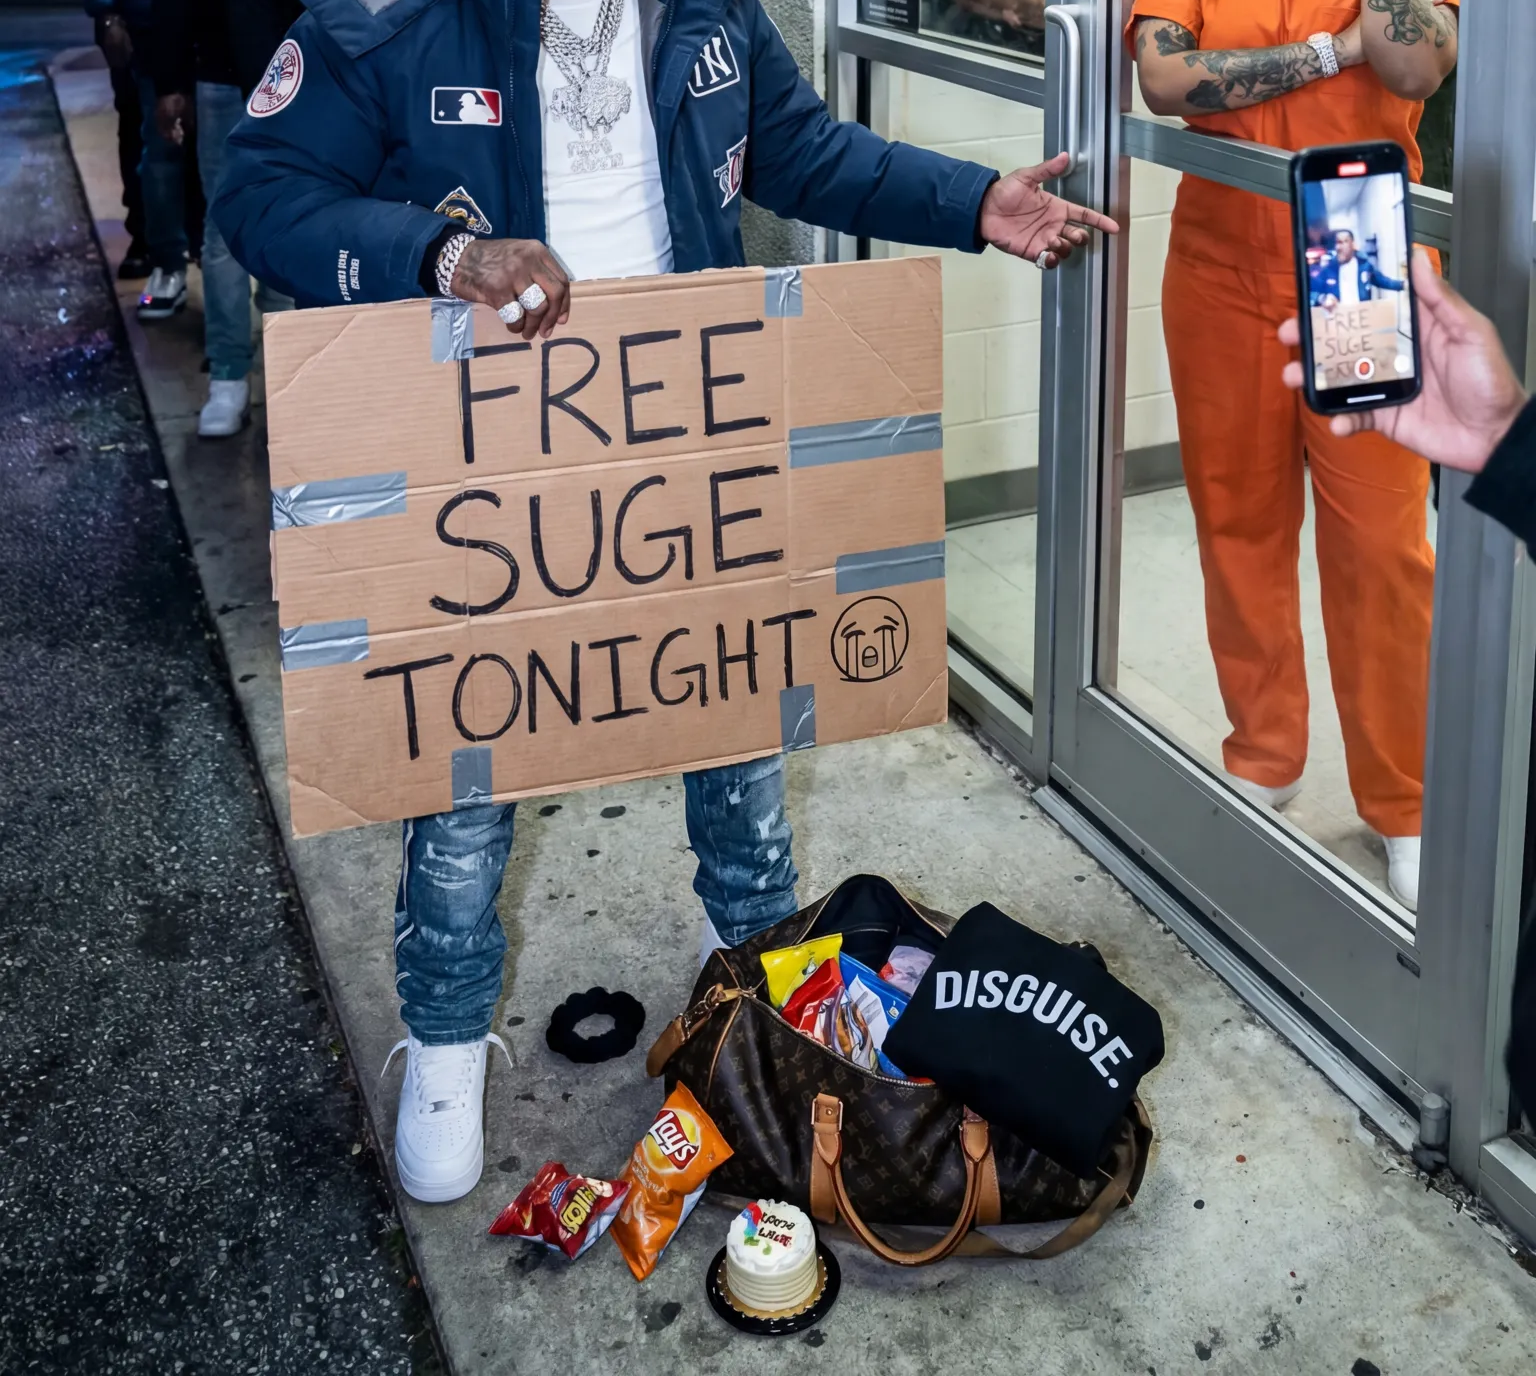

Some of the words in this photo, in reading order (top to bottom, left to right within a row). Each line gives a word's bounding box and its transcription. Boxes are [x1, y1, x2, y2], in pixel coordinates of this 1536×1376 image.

[461, 319, 771, 464] FREE
[1325, 333, 1373, 360] SUGE
[429, 464, 784, 616] SUGE
[363, 608, 818, 760] TONIGHT
[934, 969, 1135, 1090] DISGUISE.
